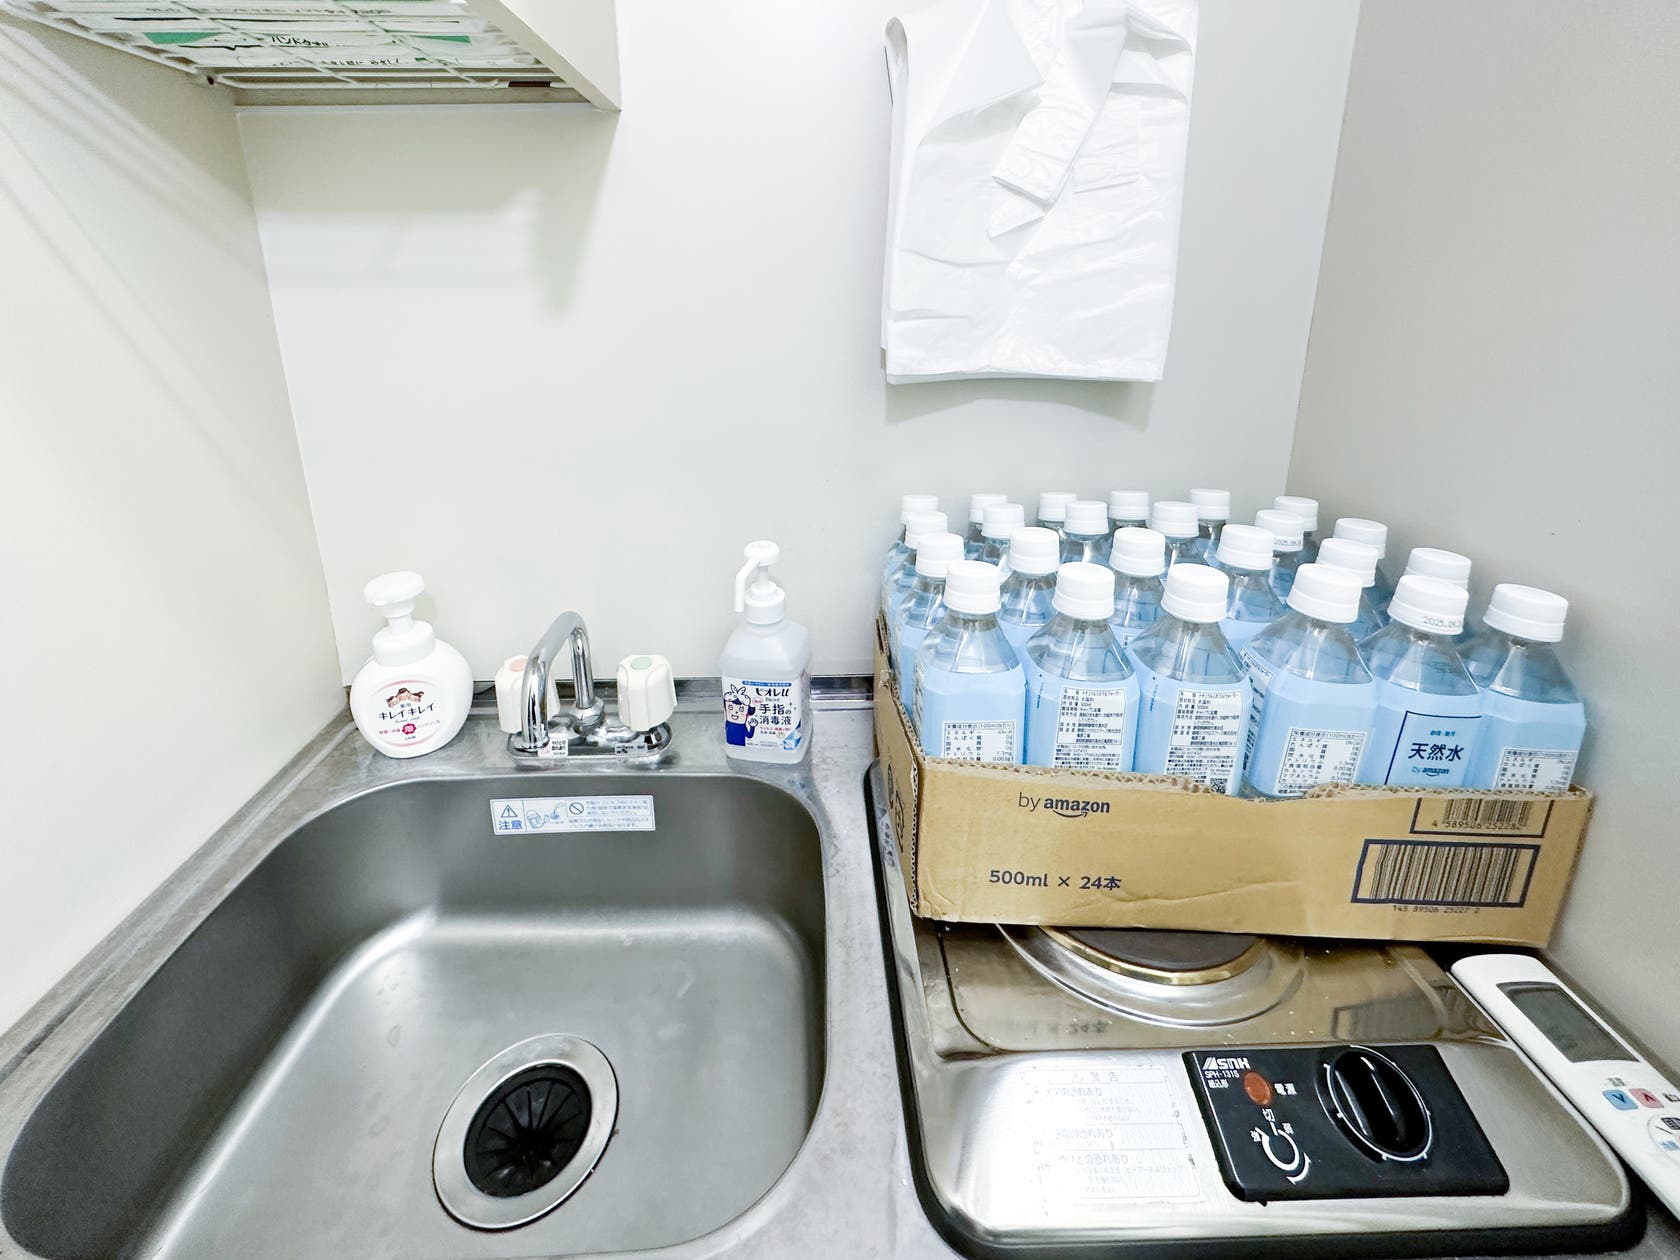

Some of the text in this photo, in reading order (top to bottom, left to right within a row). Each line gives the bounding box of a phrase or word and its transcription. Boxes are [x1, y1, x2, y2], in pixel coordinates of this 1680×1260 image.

[758, 704, 792, 715] 手指の
[759, 716, 792, 726] 消毒液
[1408, 742, 1464, 762] 天然水
[1422, 767, 1450, 776] amazon
[1018, 792, 1110, 817] by amazon
[498, 820, 523, 831] 注意
[1432, 820, 1438, 828] 4
[989, 870, 1048, 888] 500ml
[1080, 876, 1122, 891] 24本
